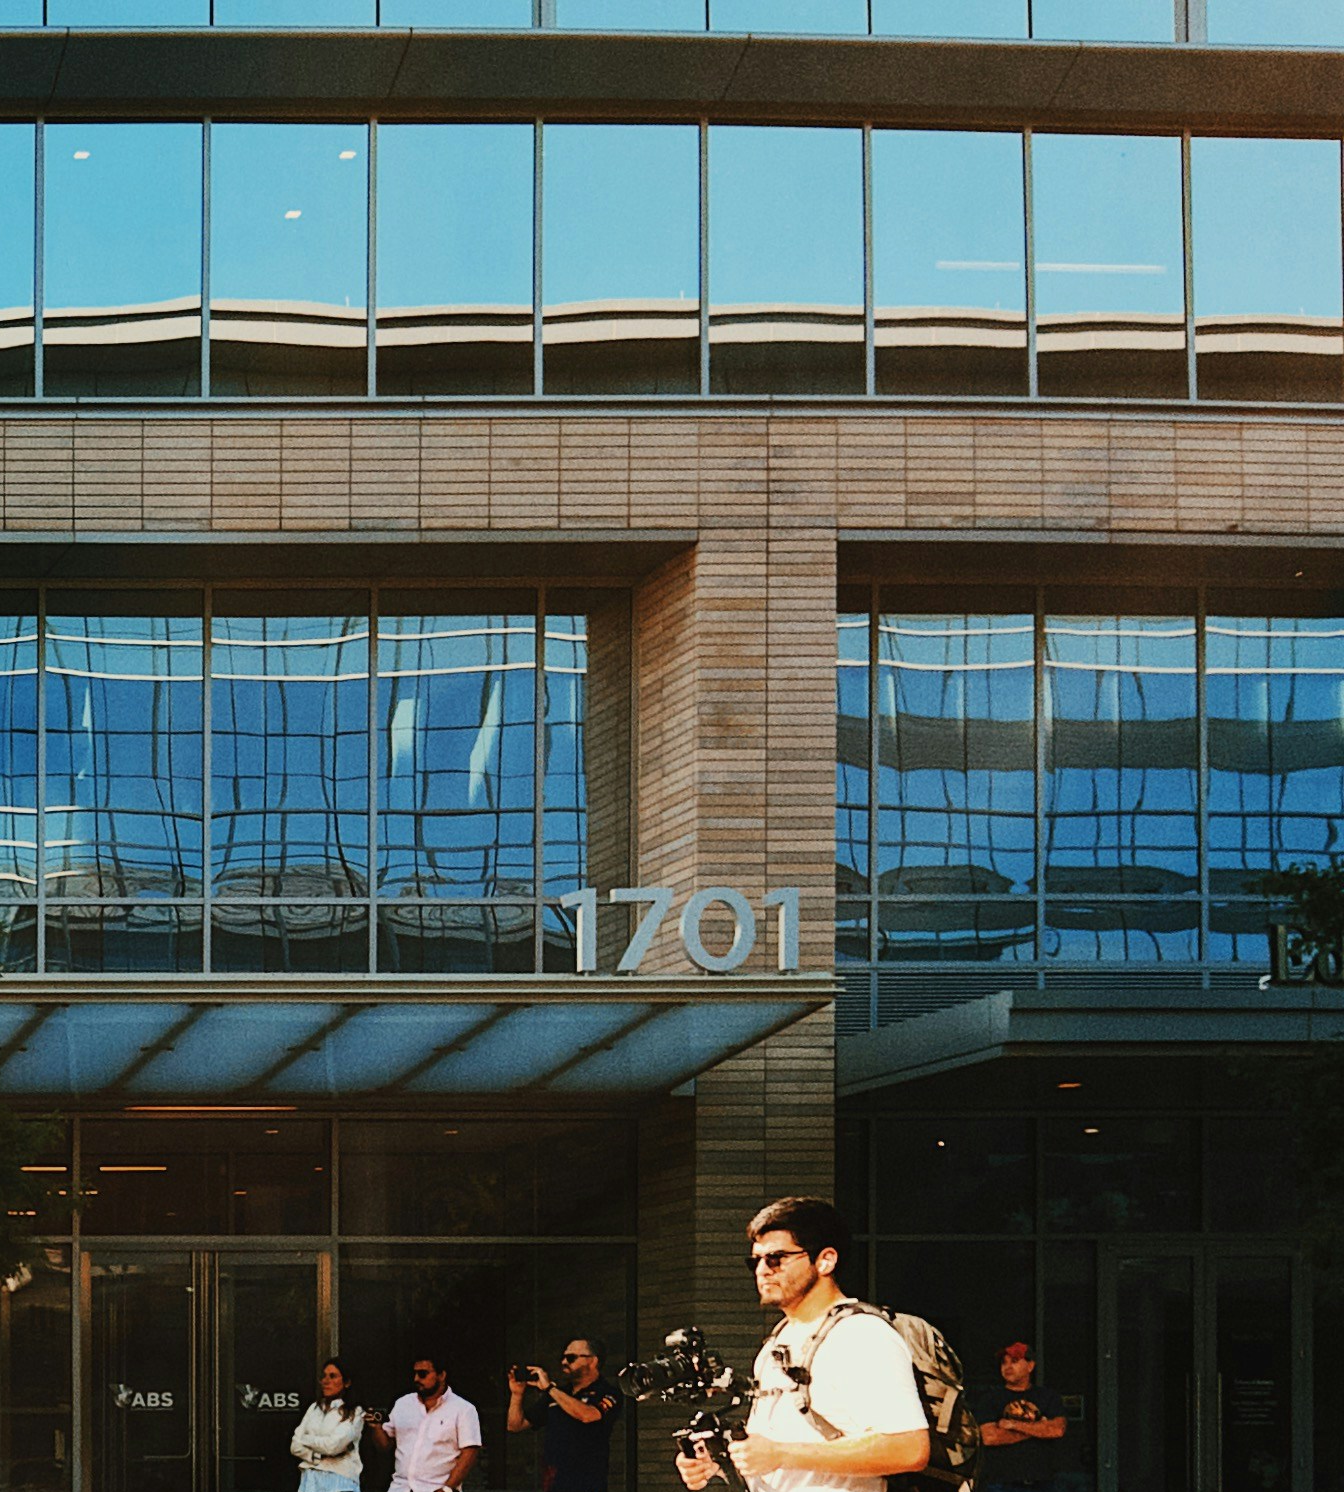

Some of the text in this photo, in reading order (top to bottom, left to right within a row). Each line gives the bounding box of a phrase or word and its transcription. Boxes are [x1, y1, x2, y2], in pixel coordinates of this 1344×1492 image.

[561, 886, 800, 972] 1701
[131, 1391, 174, 1408] ABS
[257, 1392, 300, 1408] ABS
